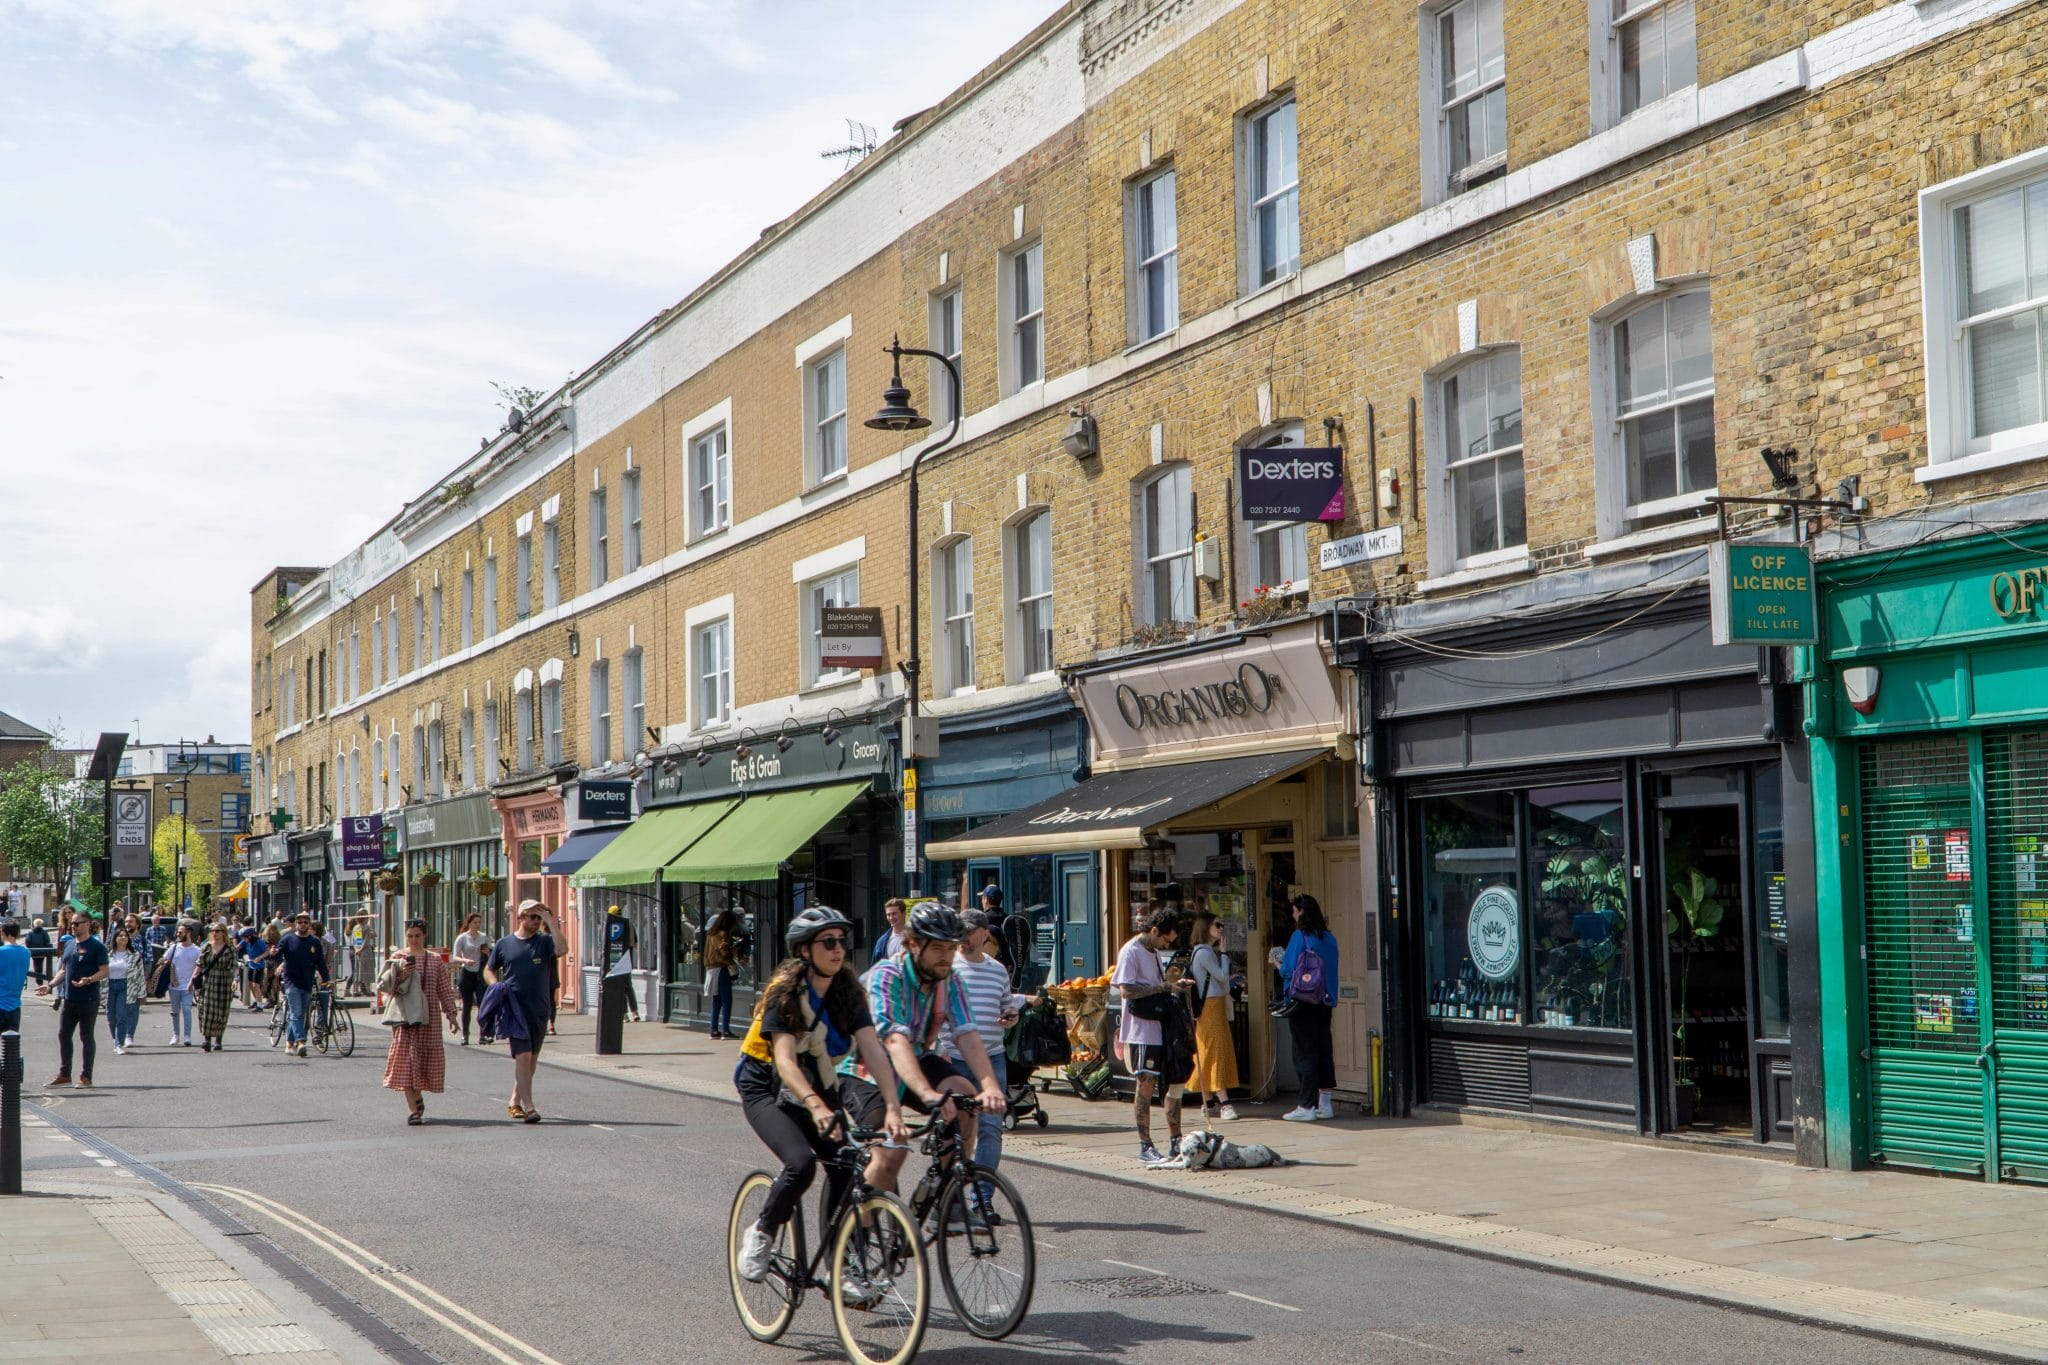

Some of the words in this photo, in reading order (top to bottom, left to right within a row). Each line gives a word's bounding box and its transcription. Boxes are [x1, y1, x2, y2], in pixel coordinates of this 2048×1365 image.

[1248, 458, 1334, 480] Dexters
[1250, 506, 1263, 514] 020
[1265, 506, 1281, 514] 7247
[1283, 506, 1300, 514] 2440
[1323, 540, 1364, 563] BROADWAY
[1368, 535, 1390, 552] MKT.
[1750, 555, 1786, 570] OFF
[1733, 575, 1807, 591] LICENCE
[1989, 566, 2048, 617] OF
[1758, 605, 1786, 614] OPEN
[827, 613, 873, 622] BlakeStanley
[1747, 619, 1768, 629] TILL
[1773, 620, 1799, 629] LATE
[827, 643, 839, 651] Let
[842, 644, 852, 652] By
[852, 740, 881, 761] Grocery
[731, 759, 747, 787] Figs
[749, 756, 755, 779] &
[756, 754, 781, 778] Grain
[585, 790, 626, 801] Dexters
[532, 806, 559, 823] HERMANOS
[346, 844, 362, 853] shop
[1473, 900, 1486, 923] NOBLE
[611, 923, 621, 937] P
